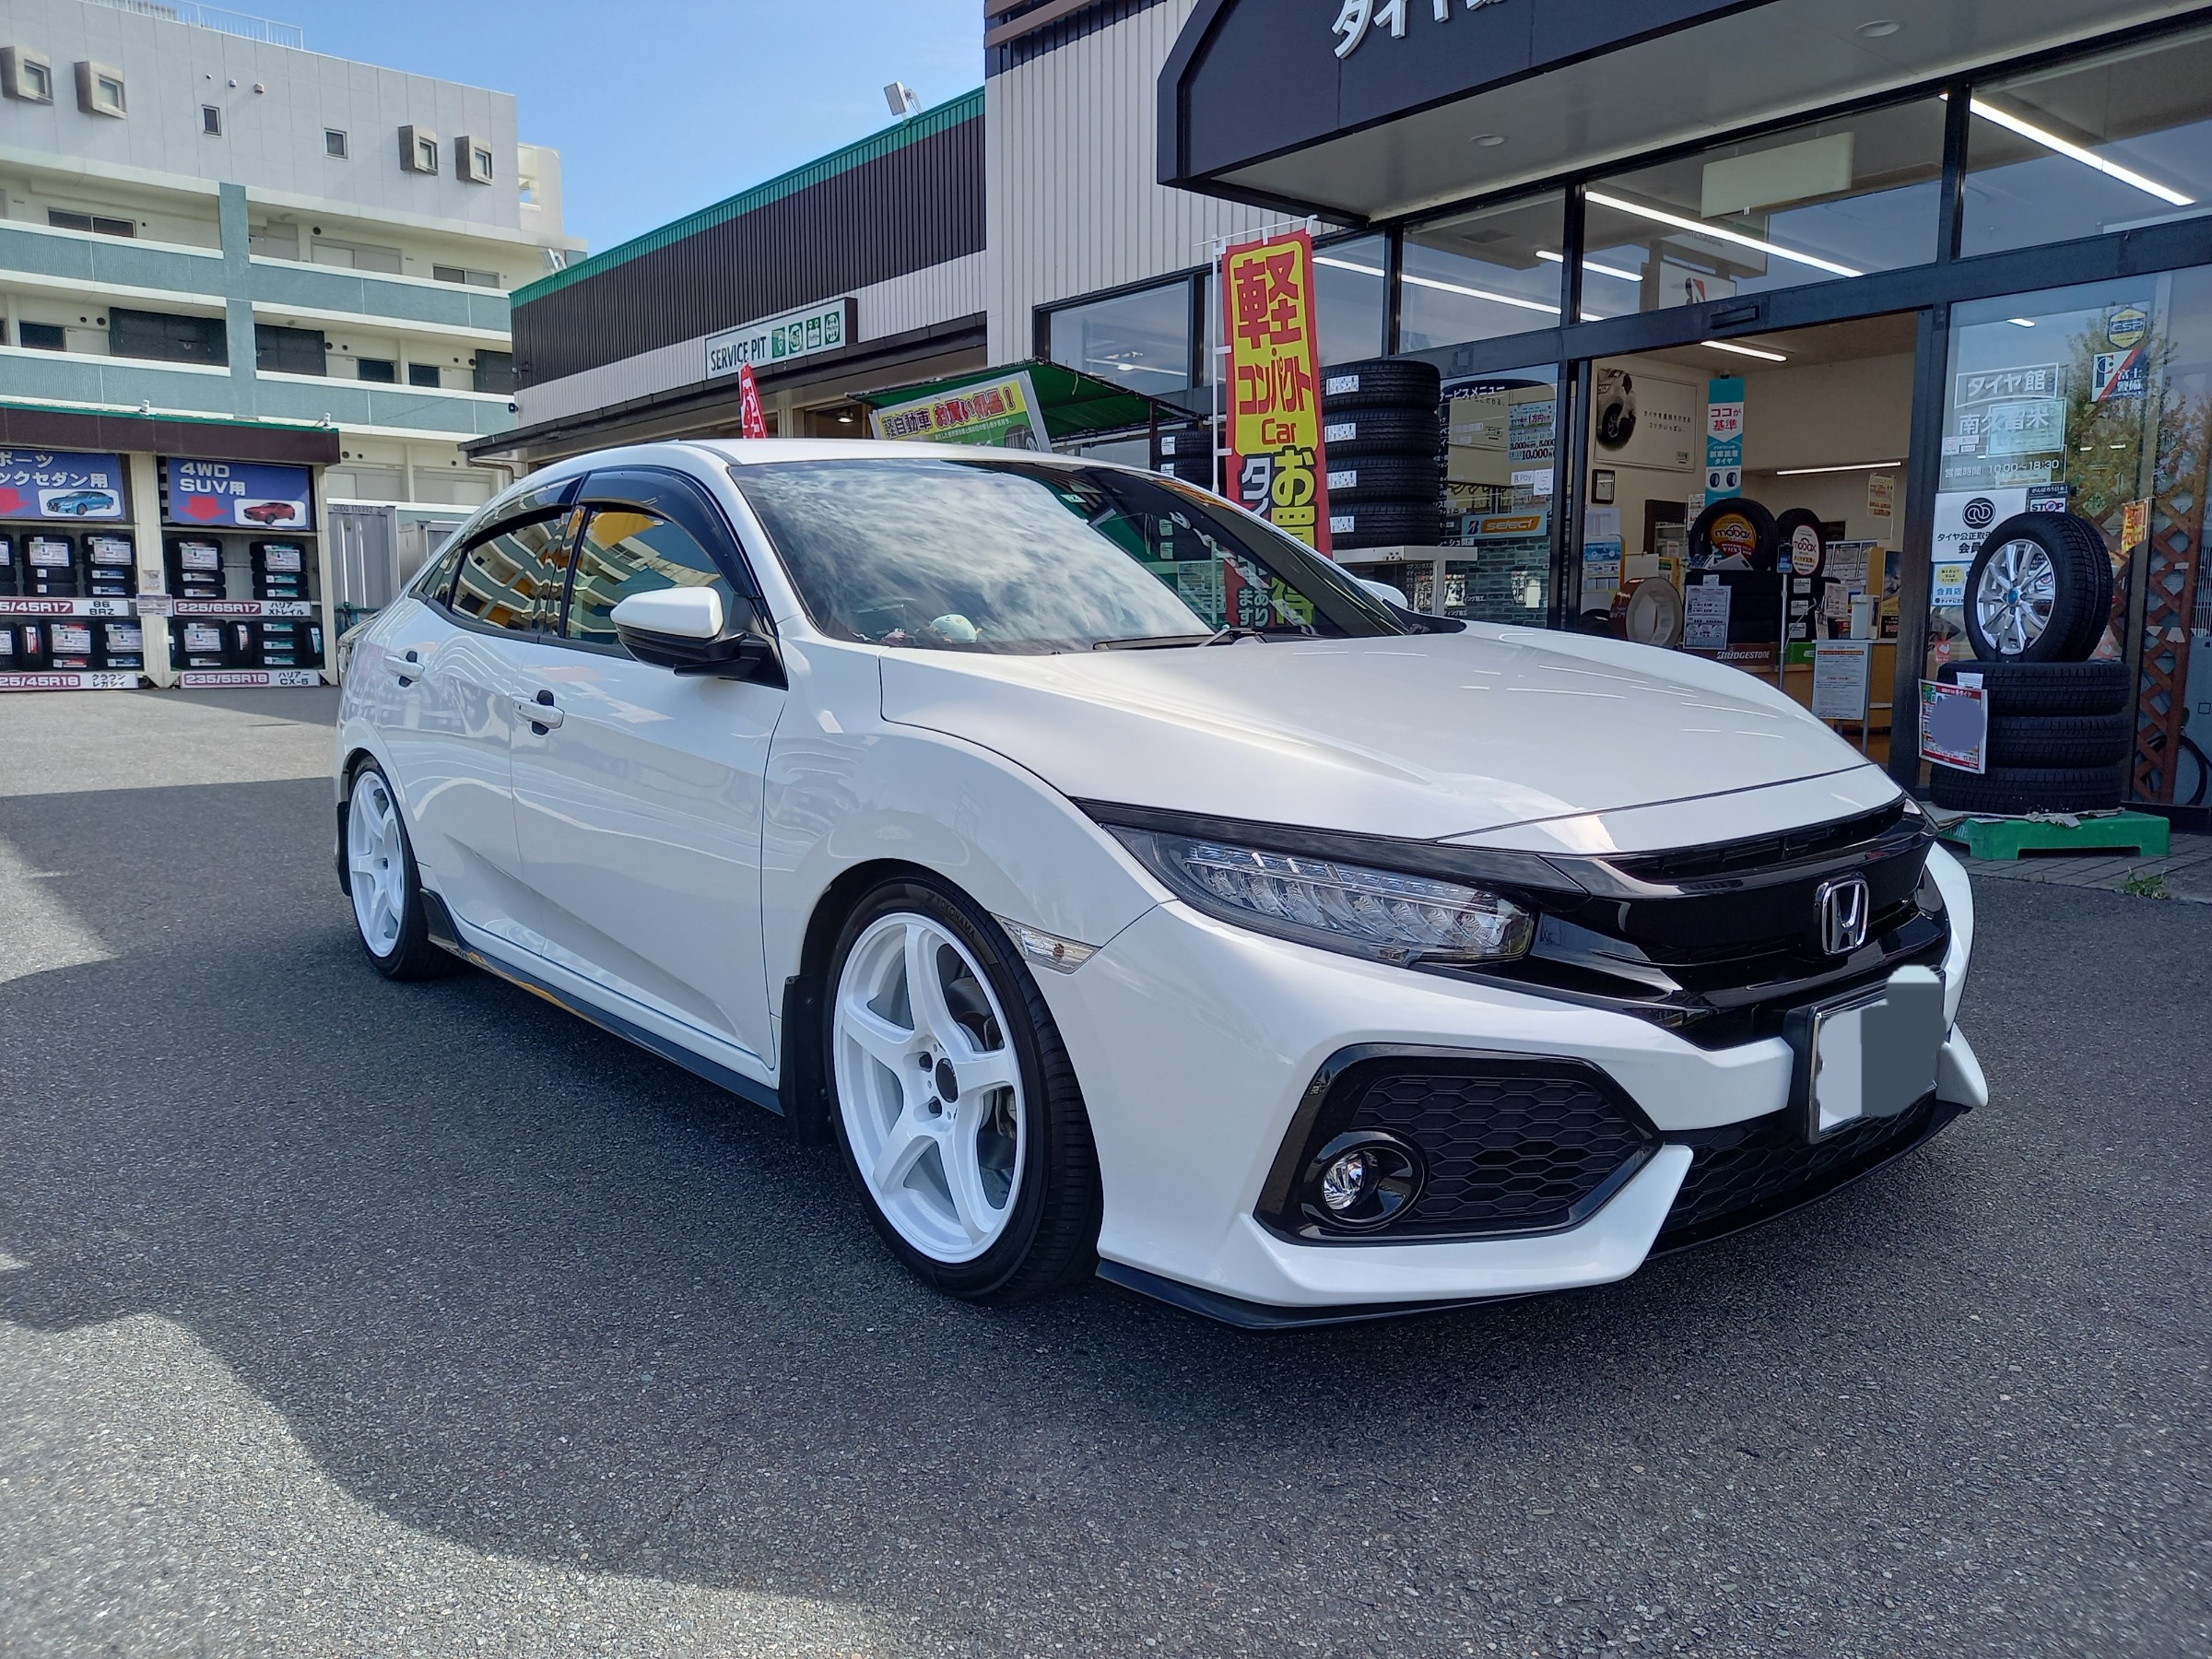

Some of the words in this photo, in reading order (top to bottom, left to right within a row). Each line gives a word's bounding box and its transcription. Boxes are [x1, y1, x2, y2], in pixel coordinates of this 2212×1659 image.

[1233, 251, 1301, 349] 軽
[711, 340, 748, 371] SERVICE
[751, 335, 767, 361] PIT
[1239, 347, 1312, 416] コンパクト
[1967, 369, 2046, 397] タイヤ館
[1710, 407, 1742, 418] ココが
[881, 408, 933, 440] 軽自動車
[1712, 418, 1737, 431] 基準
[1959, 406, 2050, 436] 南久留米
[1261, 418, 1297, 445] Car
[180, 462, 229, 478] 4WD
[1945, 465, 1982, 478] 営業時間
[179, 478, 246, 497] SUV用
[1486, 518, 1535, 532] select
[1936, 587, 1962, 595] 会員店
[0, 602, 71, 613] 5/45R17
[177, 603, 260, 614] 225/65R17
[270, 601, 302, 609] ハリアー
[1716, 650, 1771, 661] BRIDGESTONE
[185, 674, 268, 685] 235/55R18
[279, 677, 309, 686] CX-5
[935, 897, 975, 939] YOKOHAMA
